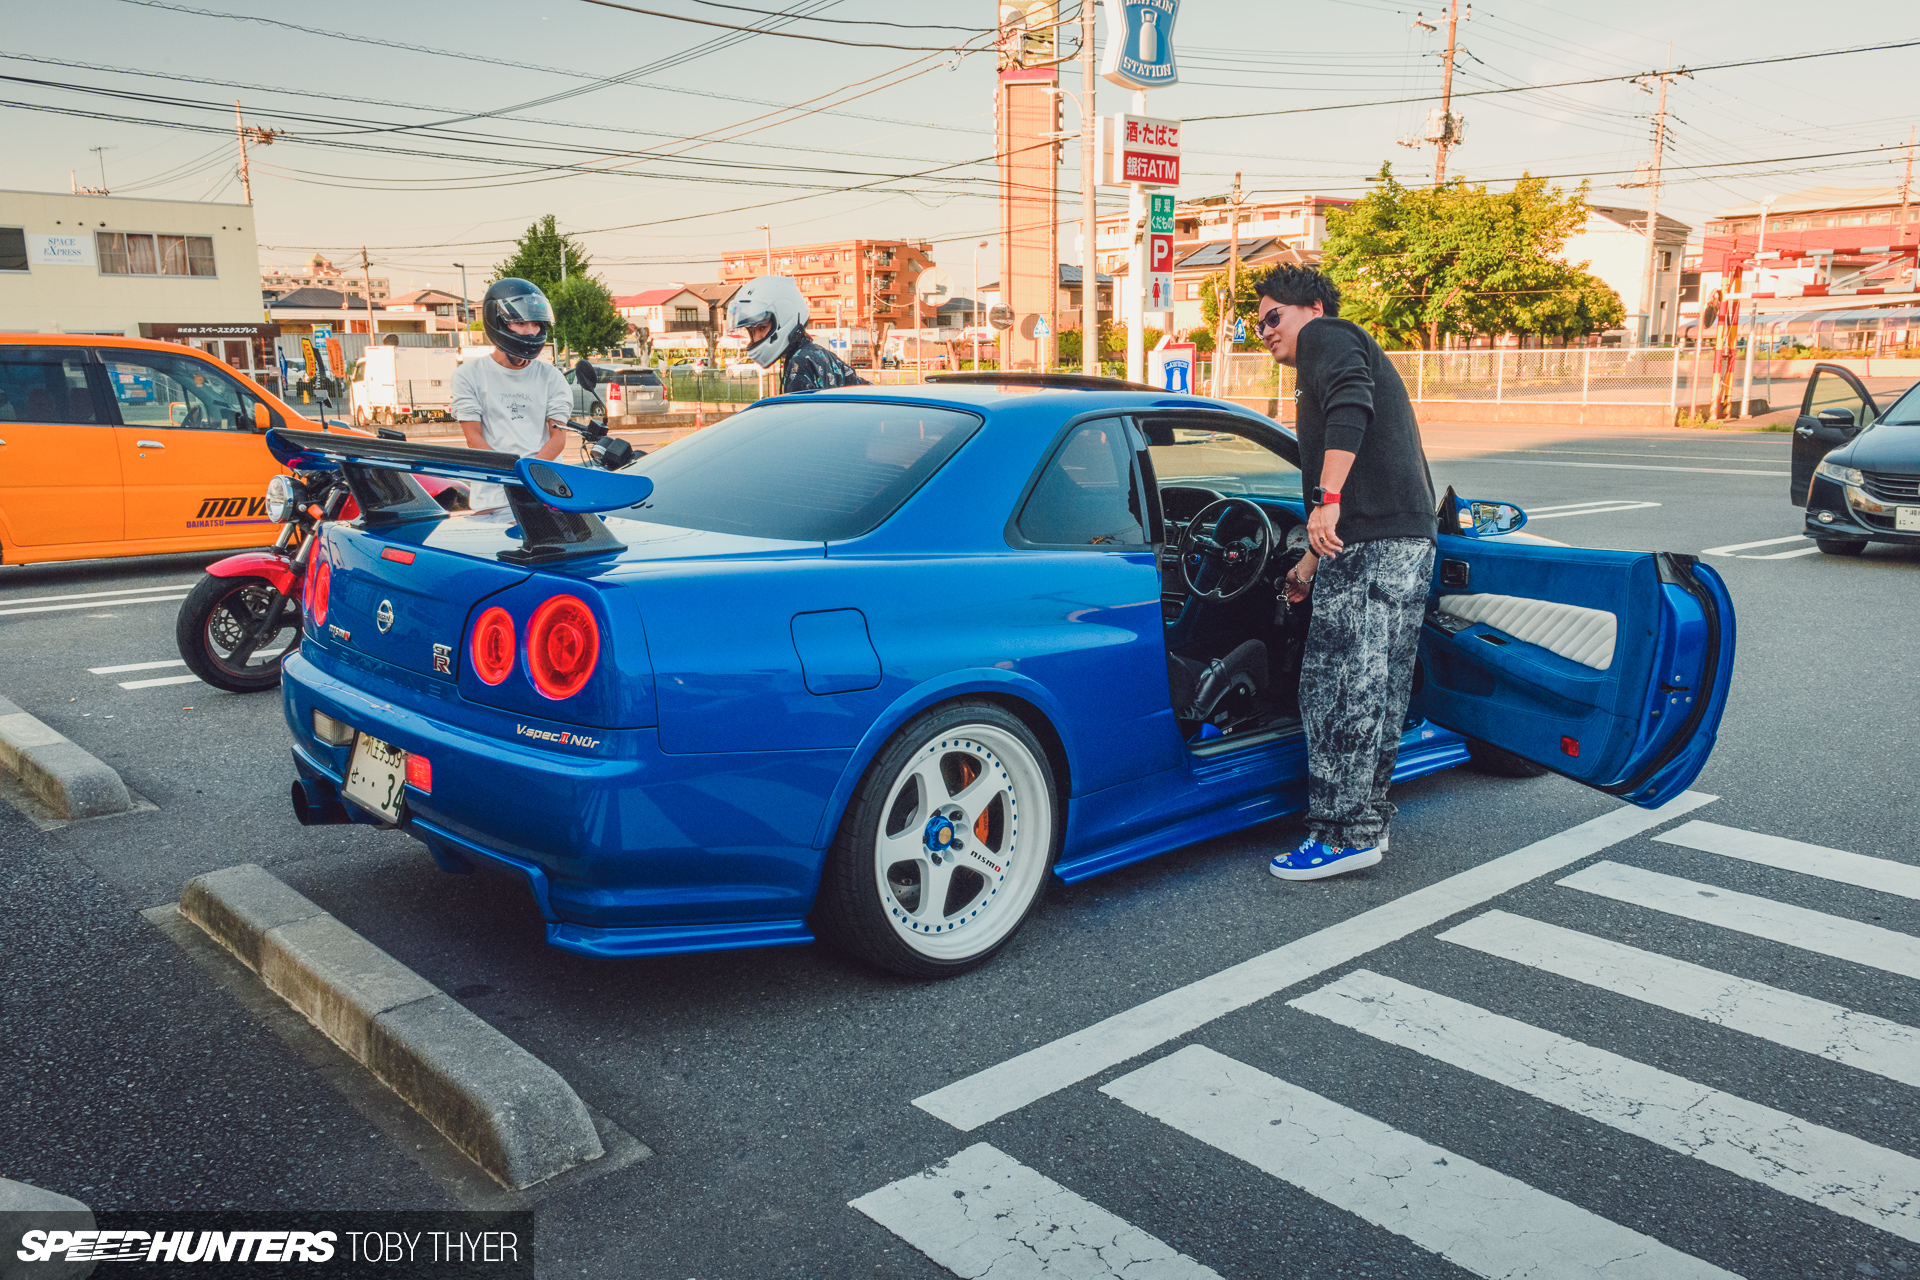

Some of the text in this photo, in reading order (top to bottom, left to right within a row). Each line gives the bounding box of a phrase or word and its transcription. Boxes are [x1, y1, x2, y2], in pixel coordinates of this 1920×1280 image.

[1123, 56, 1172, 77] STATION
[1126, 156, 1177, 180] 銀行ATM
[1154, 197, 1171, 213] 野菜
[1151, 216, 1174, 230] くだもの
[48, 237, 76, 246] SPACE
[44, 245, 82, 256] EXPRESS
[1153, 239, 1169, 268] P
[186, 519, 225, 529] DAIHATSU
[351, 767, 359, 784] せ
[970, 850, 1002, 873] nismo
